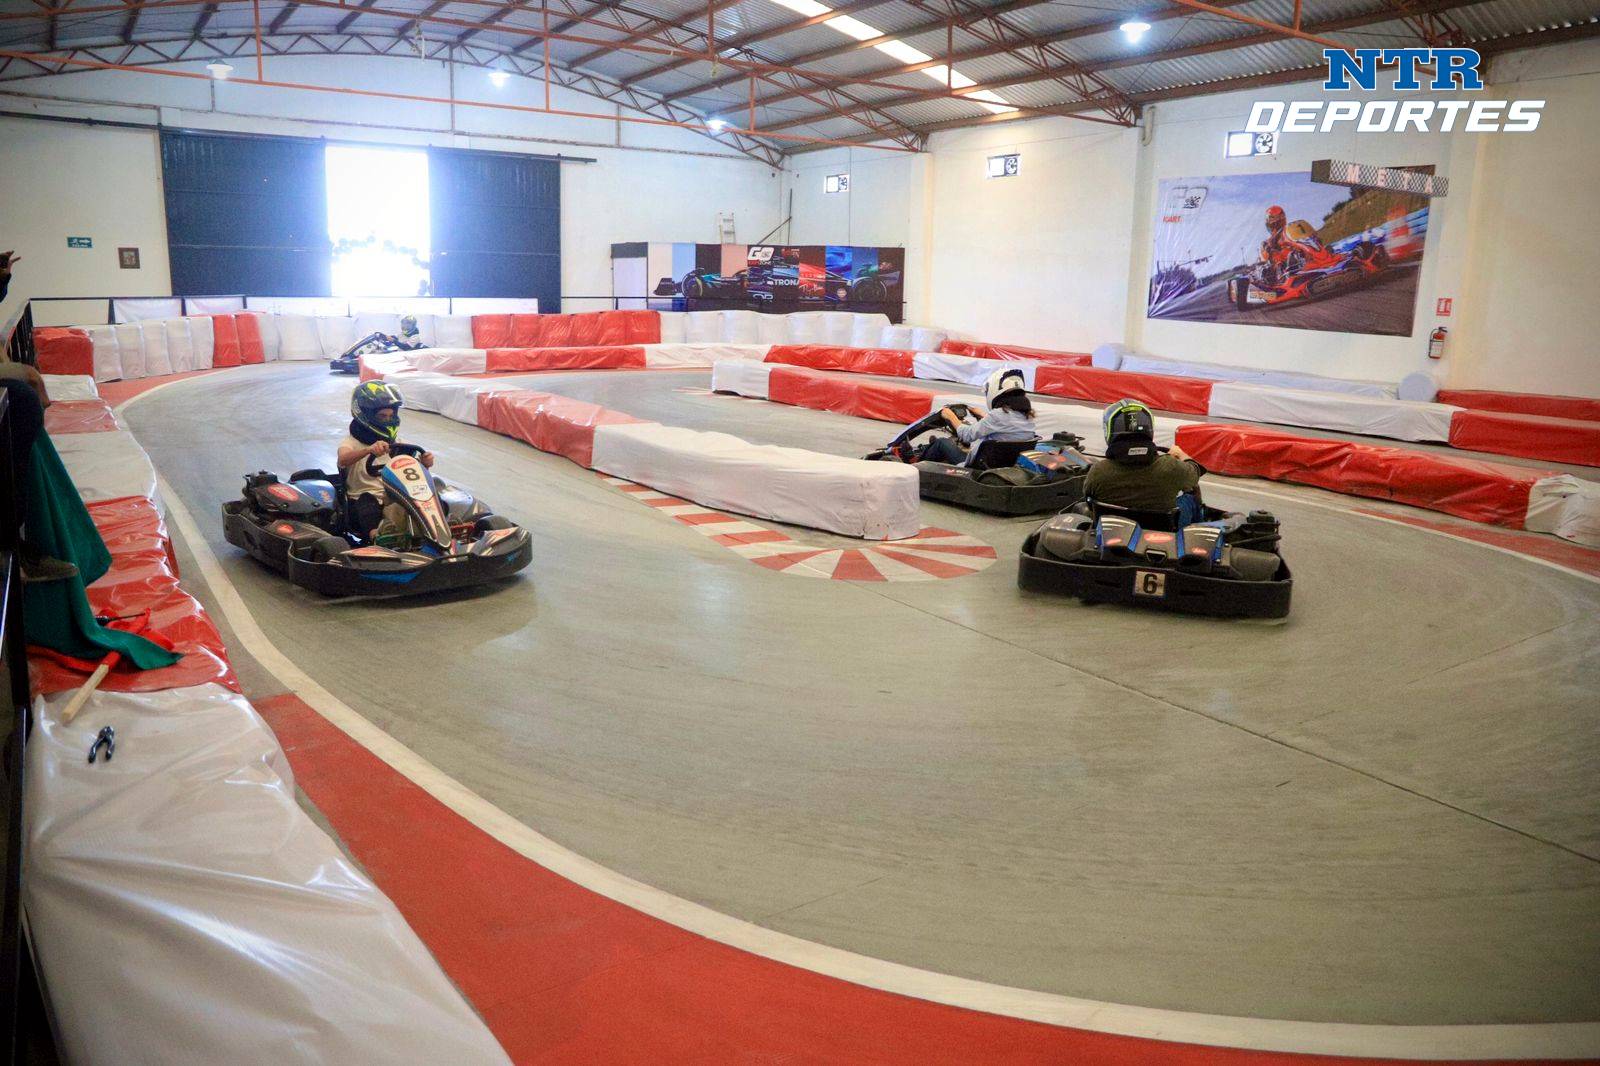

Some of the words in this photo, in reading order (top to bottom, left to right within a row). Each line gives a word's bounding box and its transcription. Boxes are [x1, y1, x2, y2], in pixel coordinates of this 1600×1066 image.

[1346, 163, 1433, 195] META
[402, 467, 420, 481] 8
[1143, 574, 1158, 594] 6
